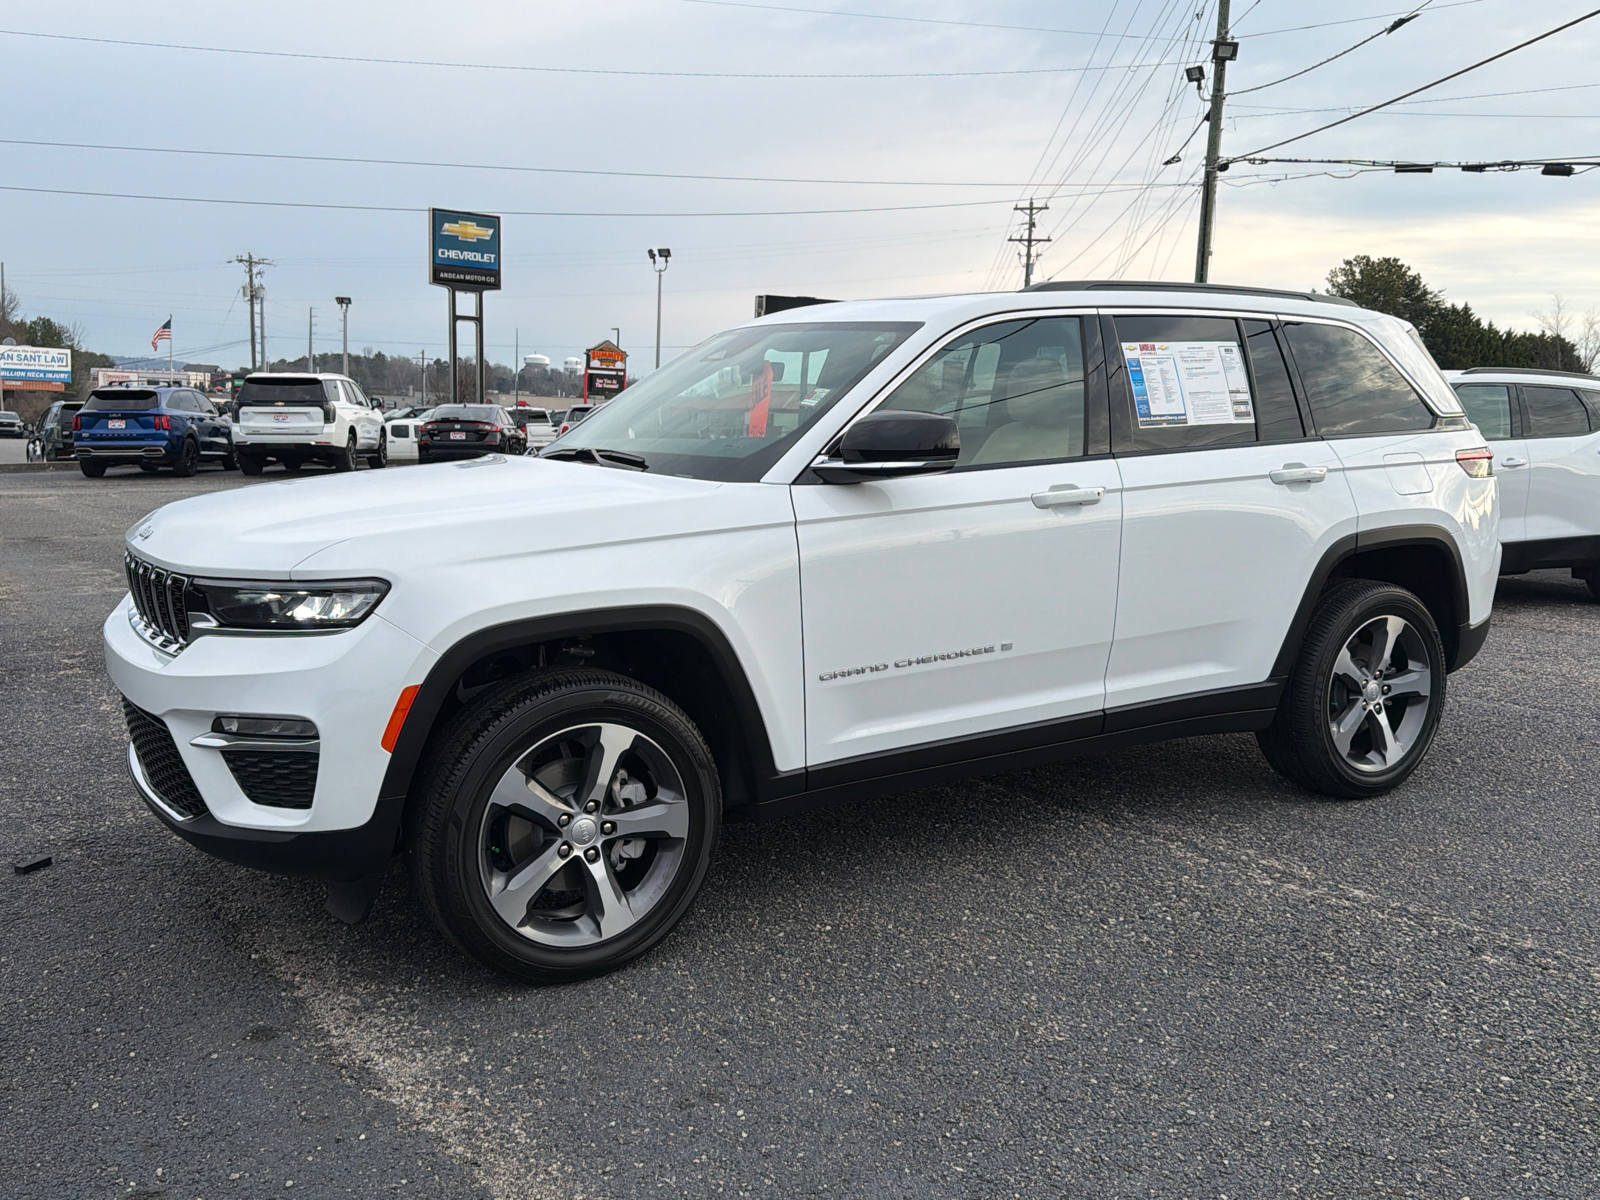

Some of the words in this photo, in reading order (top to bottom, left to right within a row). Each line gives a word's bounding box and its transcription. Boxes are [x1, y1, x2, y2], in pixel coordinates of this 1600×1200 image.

[438, 248, 496, 263] CHEVROLET
[440, 271, 464, 280] ANDEAN
[465, 274, 486, 282] MOTOR
[16, 354, 42, 363] SANT
[44, 355, 65, 364] LAW
[591, 350, 625, 363] SUMMITS
[818, 661, 889, 682] GRAND
[894, 644, 996, 669] CHEROKEE
[603, 692, 706, 767] BRIDGESTONE
